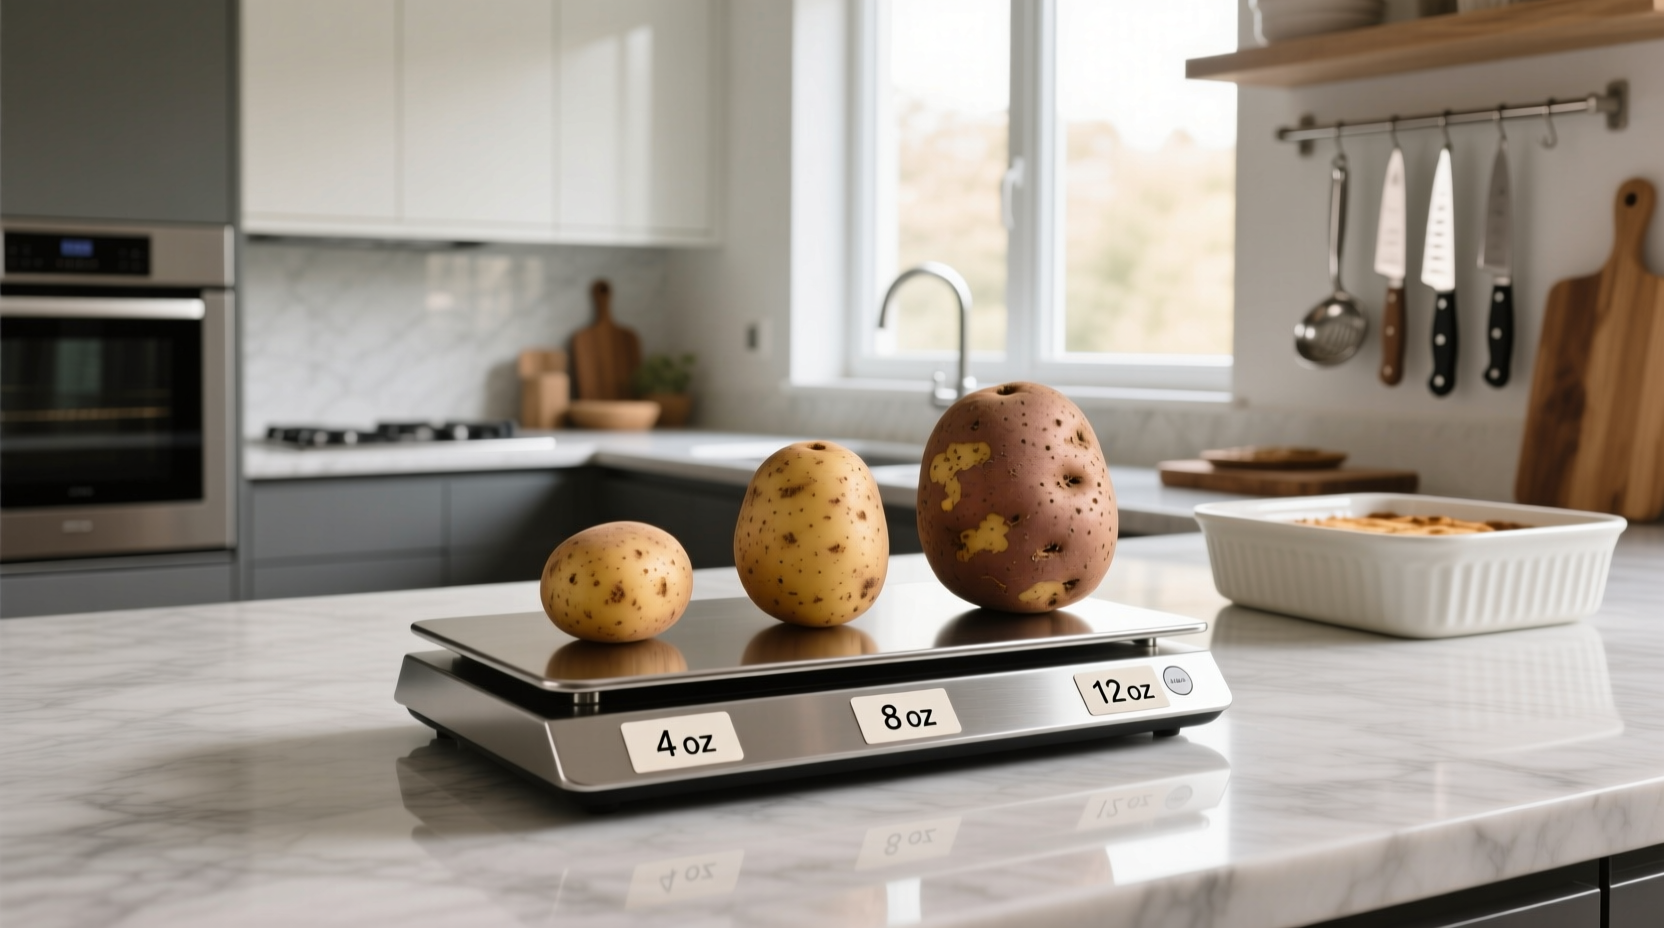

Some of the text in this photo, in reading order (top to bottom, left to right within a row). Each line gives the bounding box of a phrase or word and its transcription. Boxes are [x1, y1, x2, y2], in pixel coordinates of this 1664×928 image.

[881, 704, 937, 731] 8 oz
[656, 729, 717, 757] 4 oz
